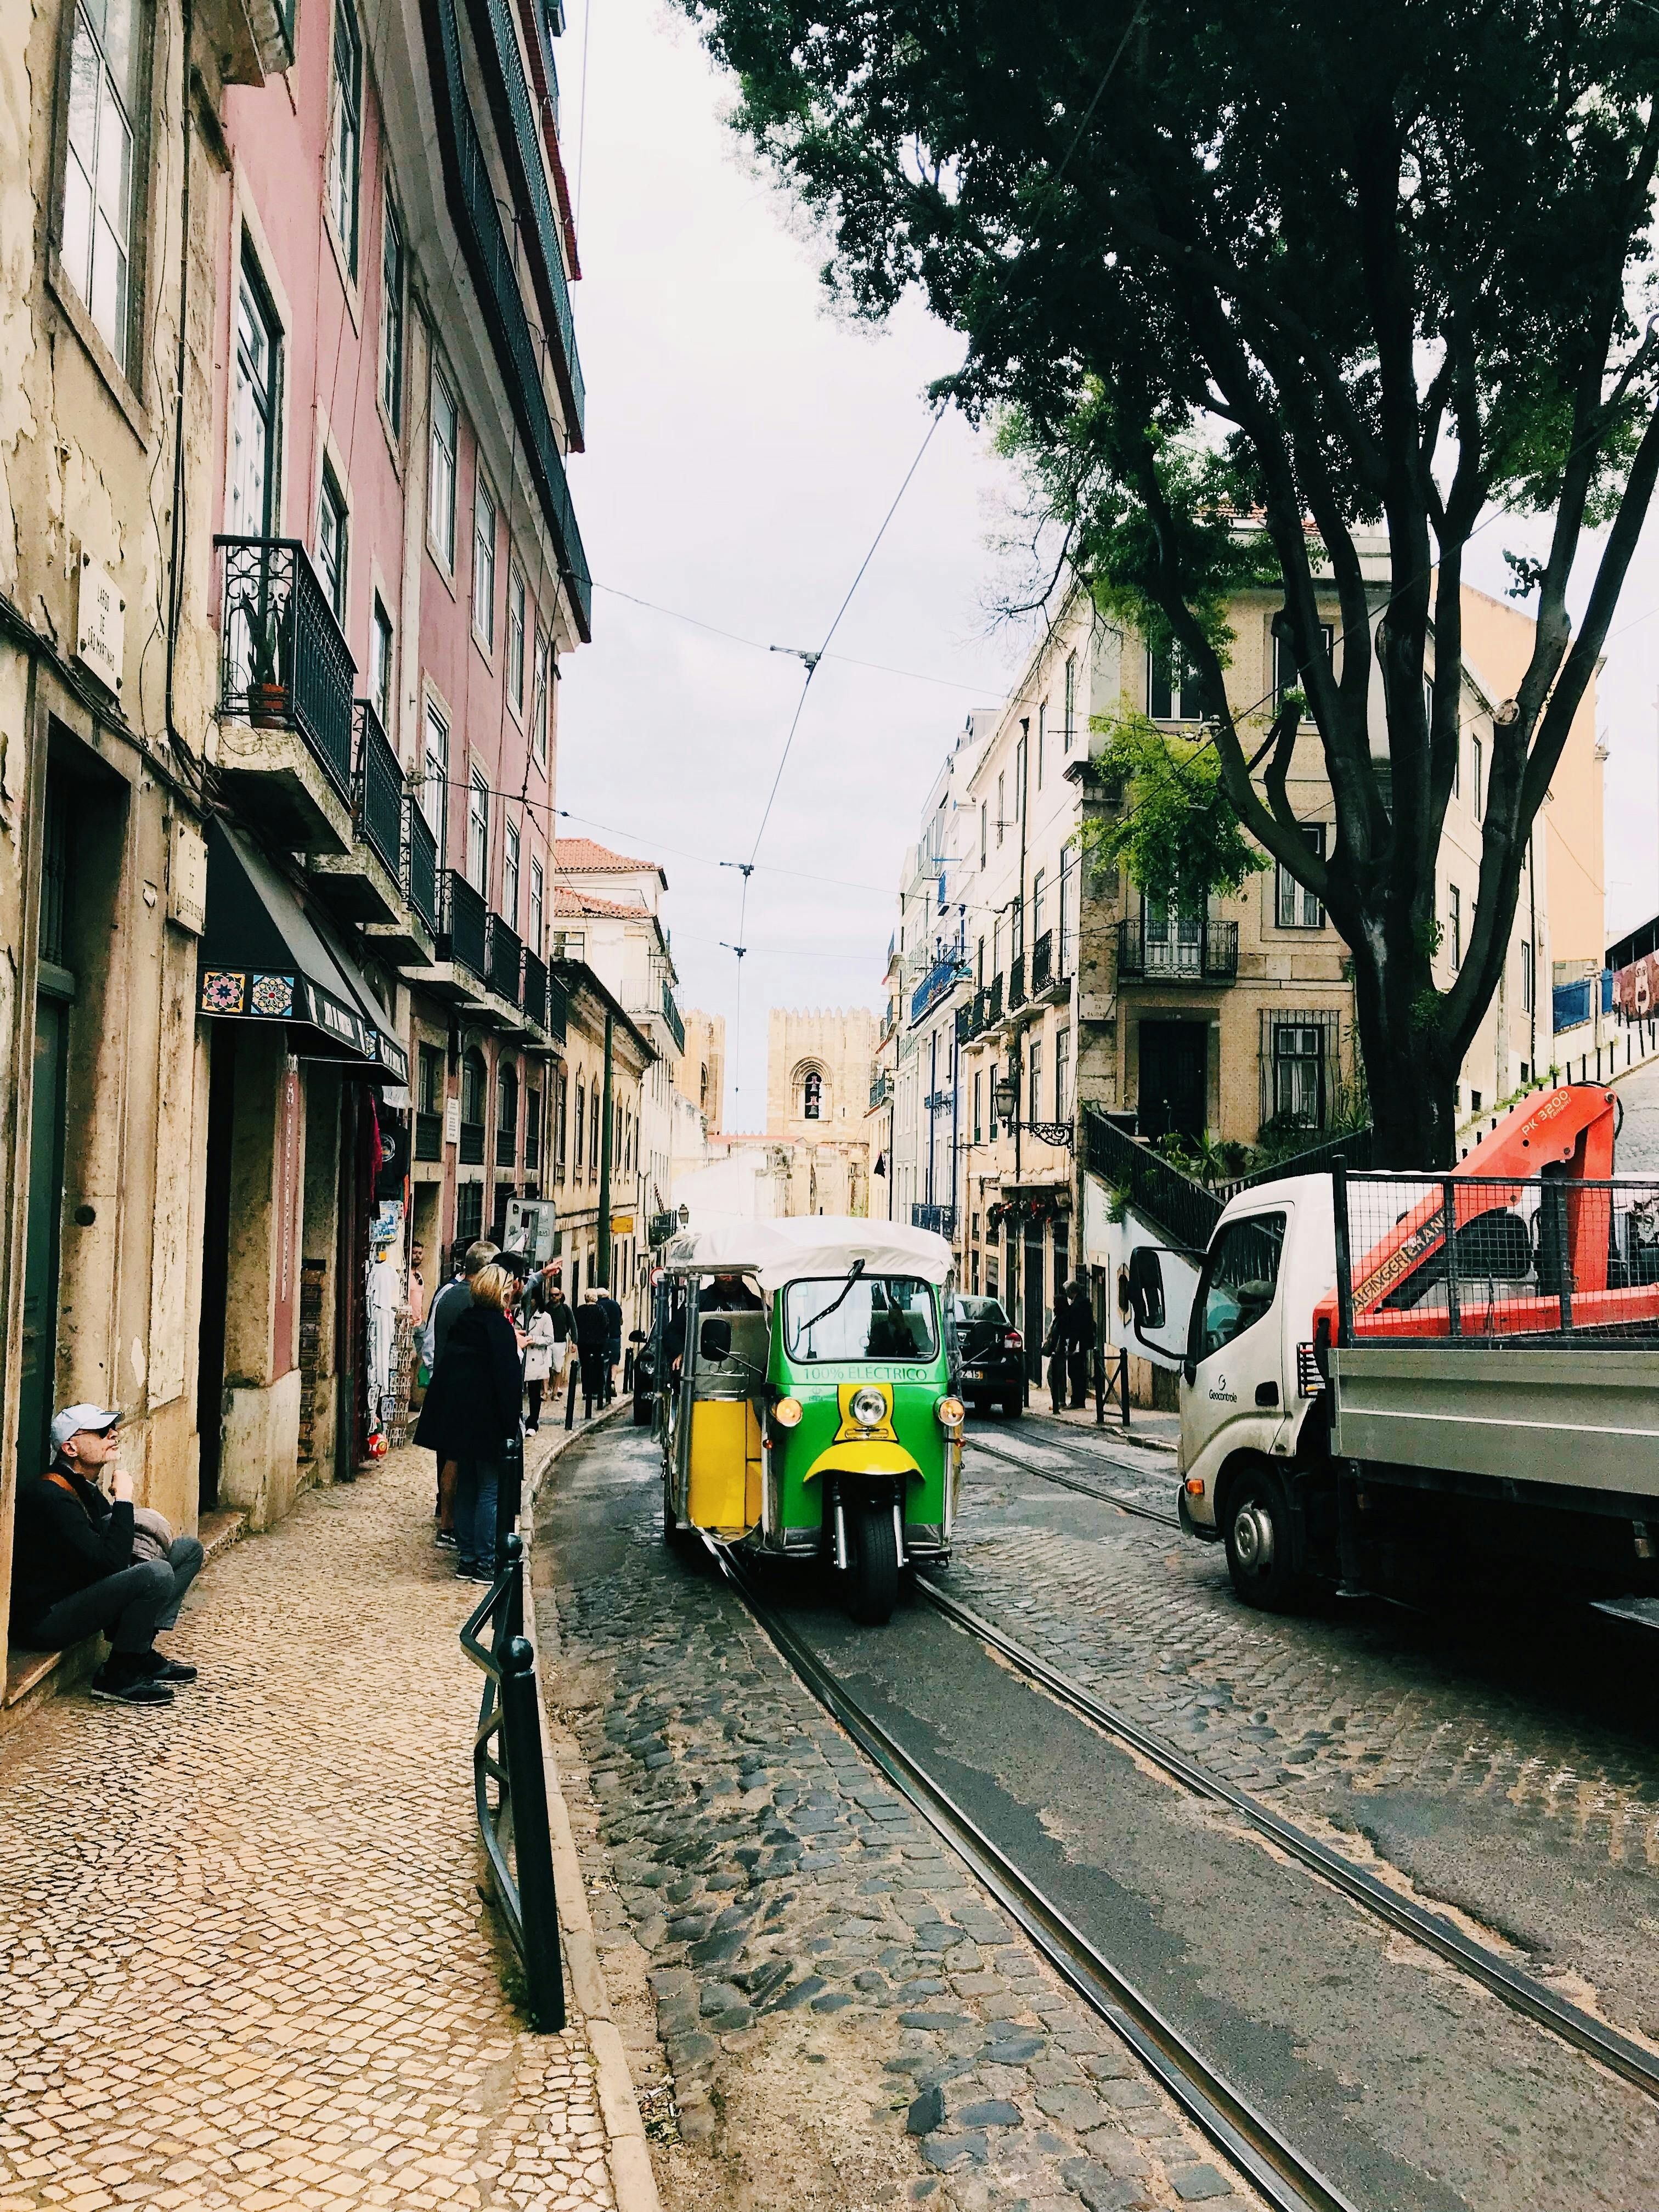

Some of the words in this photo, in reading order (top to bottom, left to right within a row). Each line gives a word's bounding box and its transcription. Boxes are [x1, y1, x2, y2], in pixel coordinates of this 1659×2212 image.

[97, 583, 110, 612] LARGO
[100, 614, 105, 635] DE
[96, 637, 115, 672] MARTINHO
[1521, 1118, 1539, 1136] PK
[1537, 1090, 1568, 1121] 3200
[1352, 1252, 1410, 1312] ALFINGER
[804, 1367, 844, 1380] 100%
[849, 1364, 927, 1381] ELÉCTRICO
[1209, 1389, 1237, 1403] Geocontrole
